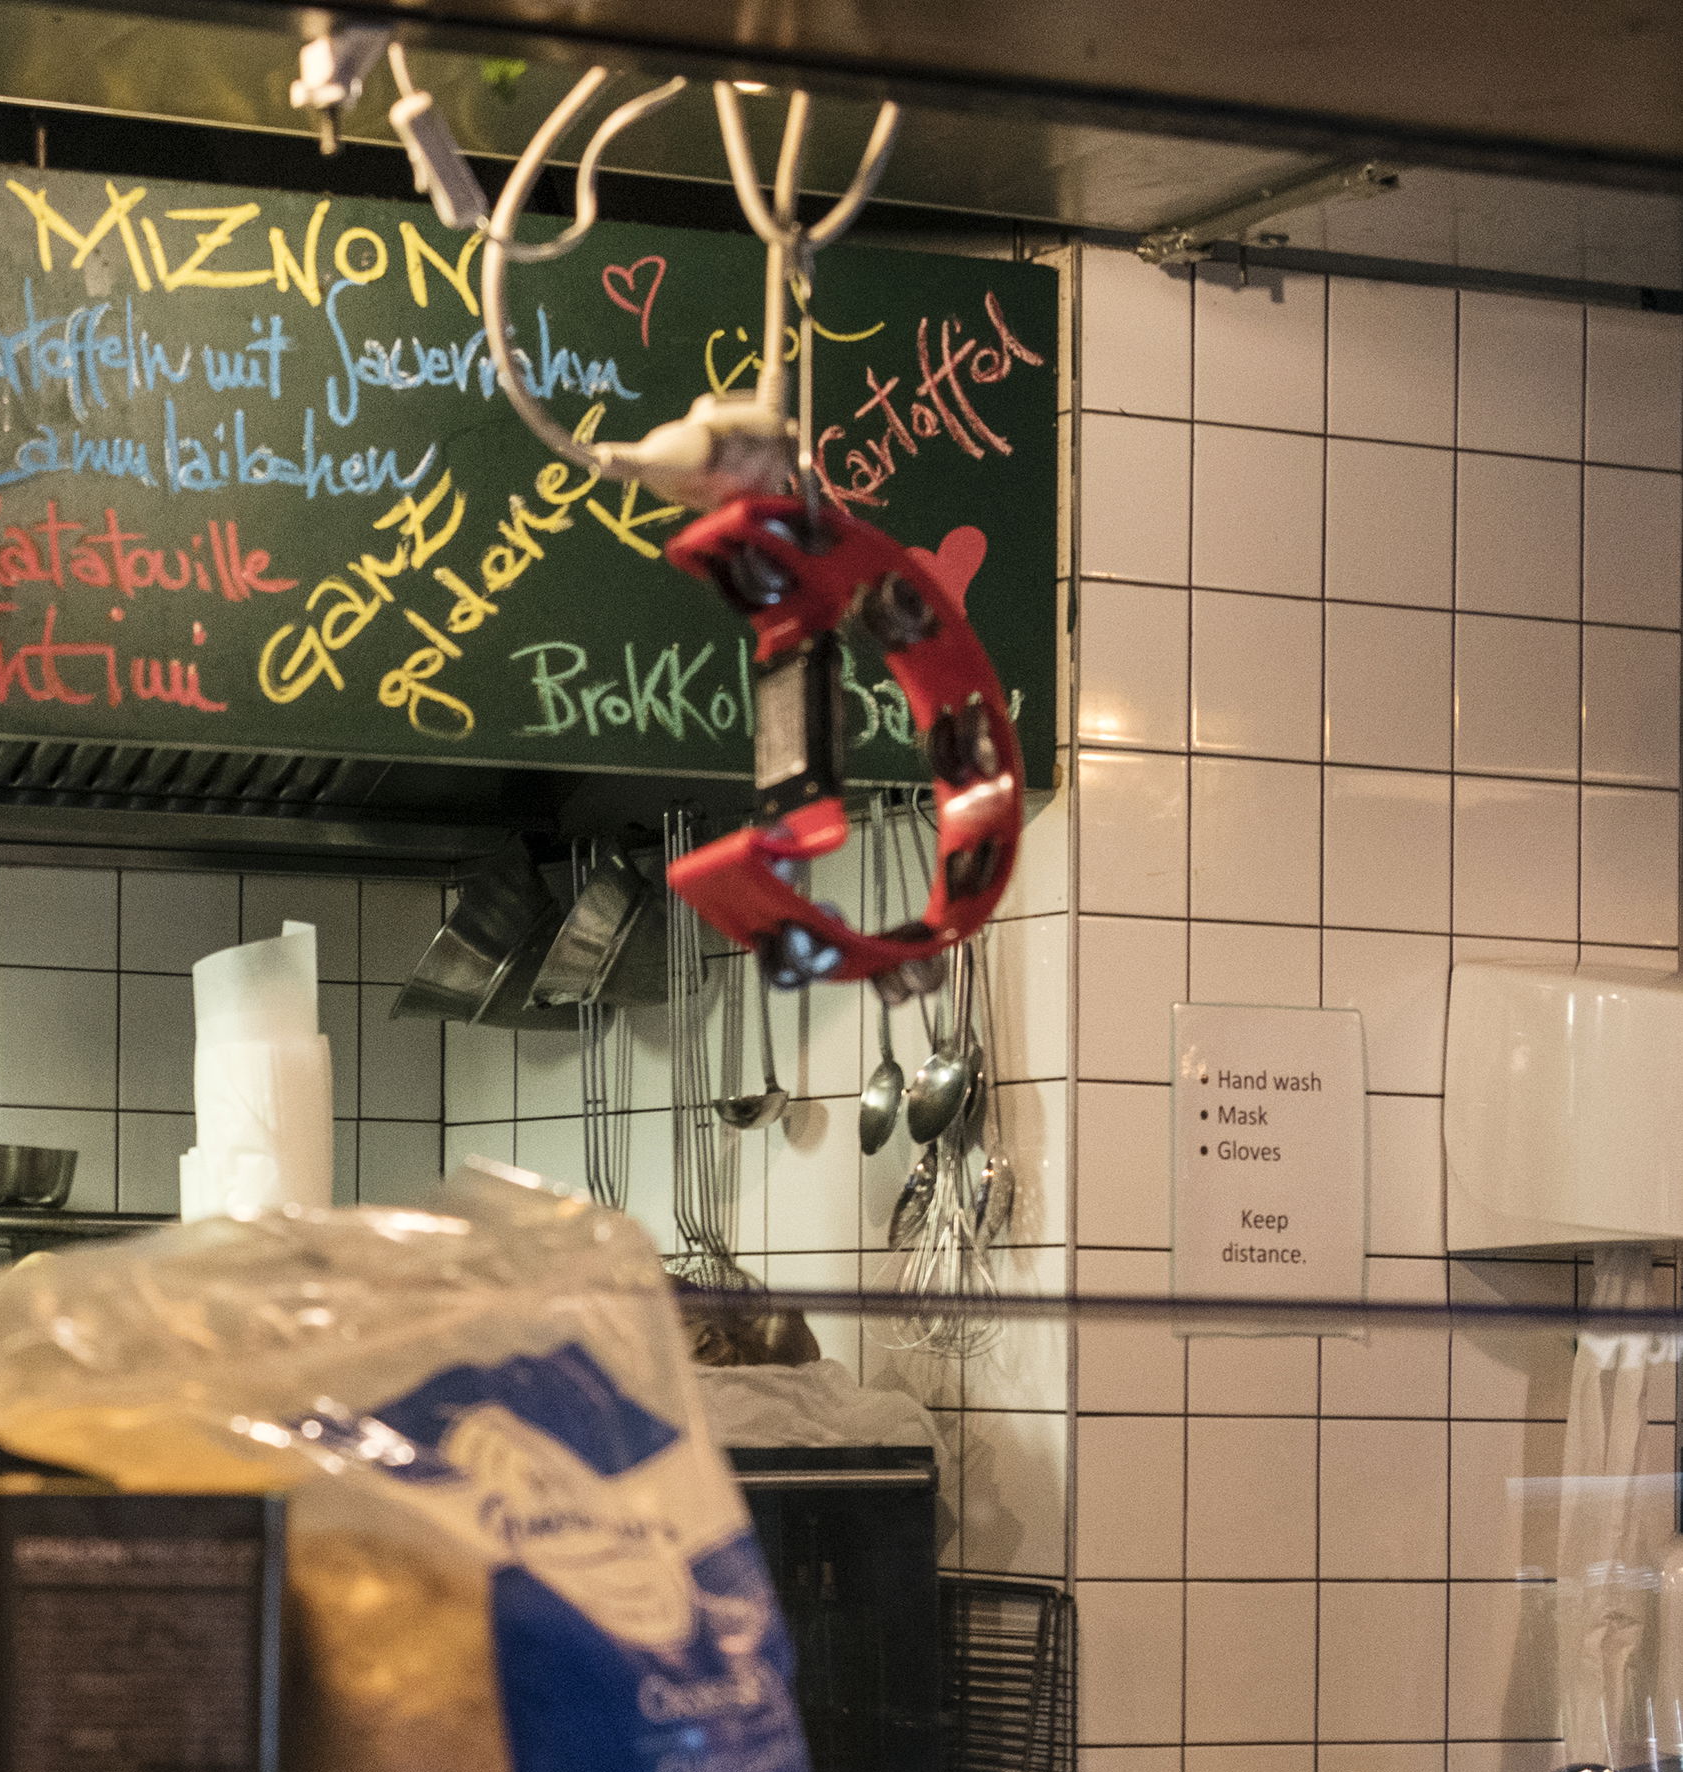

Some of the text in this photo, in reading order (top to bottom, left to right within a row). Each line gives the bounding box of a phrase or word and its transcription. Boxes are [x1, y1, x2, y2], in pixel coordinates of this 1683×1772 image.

[6, 178, 487, 316] MIZNON
[1217, 1070, 1322, 1092] Hand wash
[1217, 1105, 1268, 1126] Mask
[1217, 1140, 1281, 1162] Gloves
[1241, 1209, 1289, 1233] Keep
[1221, 1242, 1307, 1265] distance.
